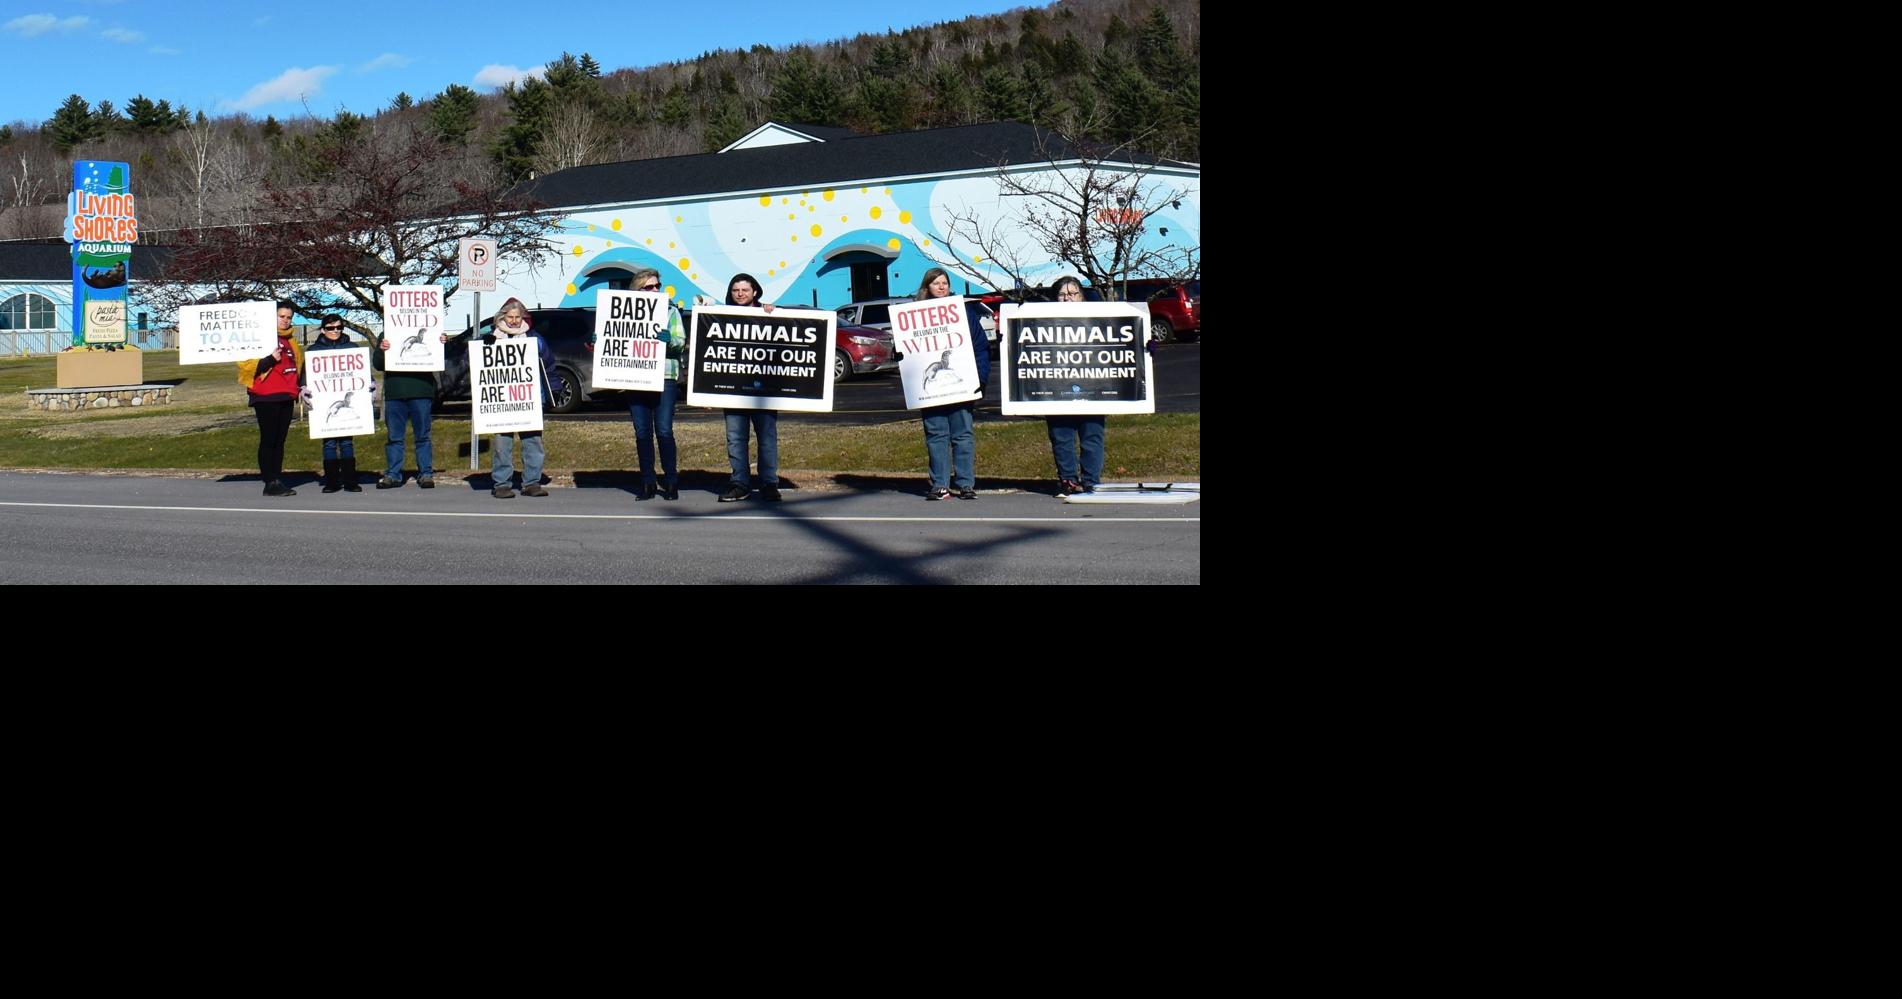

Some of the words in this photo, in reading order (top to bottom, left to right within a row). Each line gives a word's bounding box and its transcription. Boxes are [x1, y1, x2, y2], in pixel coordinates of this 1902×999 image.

[78, 243, 132, 254] AQUARIUM
[472, 269, 484, 278] NO
[462, 278, 494, 288] PARKING
[389, 290, 438, 308] OTTERS
[610, 296, 658, 321] BABY
[200, 320, 260, 331] MATTERS
[390, 314, 438, 328] WILD
[897, 303, 960, 332] OTTERS
[200, 333, 222, 345] TO
[229, 331, 261, 344] ALL
[603, 320, 661, 340] ANIMALS
[706, 322, 817, 343] ANIMALS
[912, 328, 933, 338] BELONG
[932, 327, 939, 335] IN
[939, 325, 949, 334] THE
[1018, 325, 1134, 344] ANIMALS
[602, 338, 629, 357] ARE
[632, 340, 660, 359] NOT
[902, 331, 964, 355] WILD
[312, 353, 364, 373] OTTERS
[482, 343, 527, 368] BABY
[704, 345, 737, 360] ARE
[741, 347, 777, 362] NOT
[781, 349, 817, 364] OUR
[1018, 351, 1051, 365] ARE
[1056, 350, 1093, 364] NOT
[1097, 350, 1136, 364] OUR
[600, 357, 658, 370] ENTERTAINMENT
[703, 361, 817, 378] ENTERTAINMENT
[479, 366, 533, 385] ANIMALS
[1018, 367, 1136, 379] ENTERTAINMENT
[313, 377, 365, 393] WILD
[480, 386, 506, 403] ARE
[508, 384, 534, 401] NOT
[479, 402, 534, 414] ENTERTAINMENT
